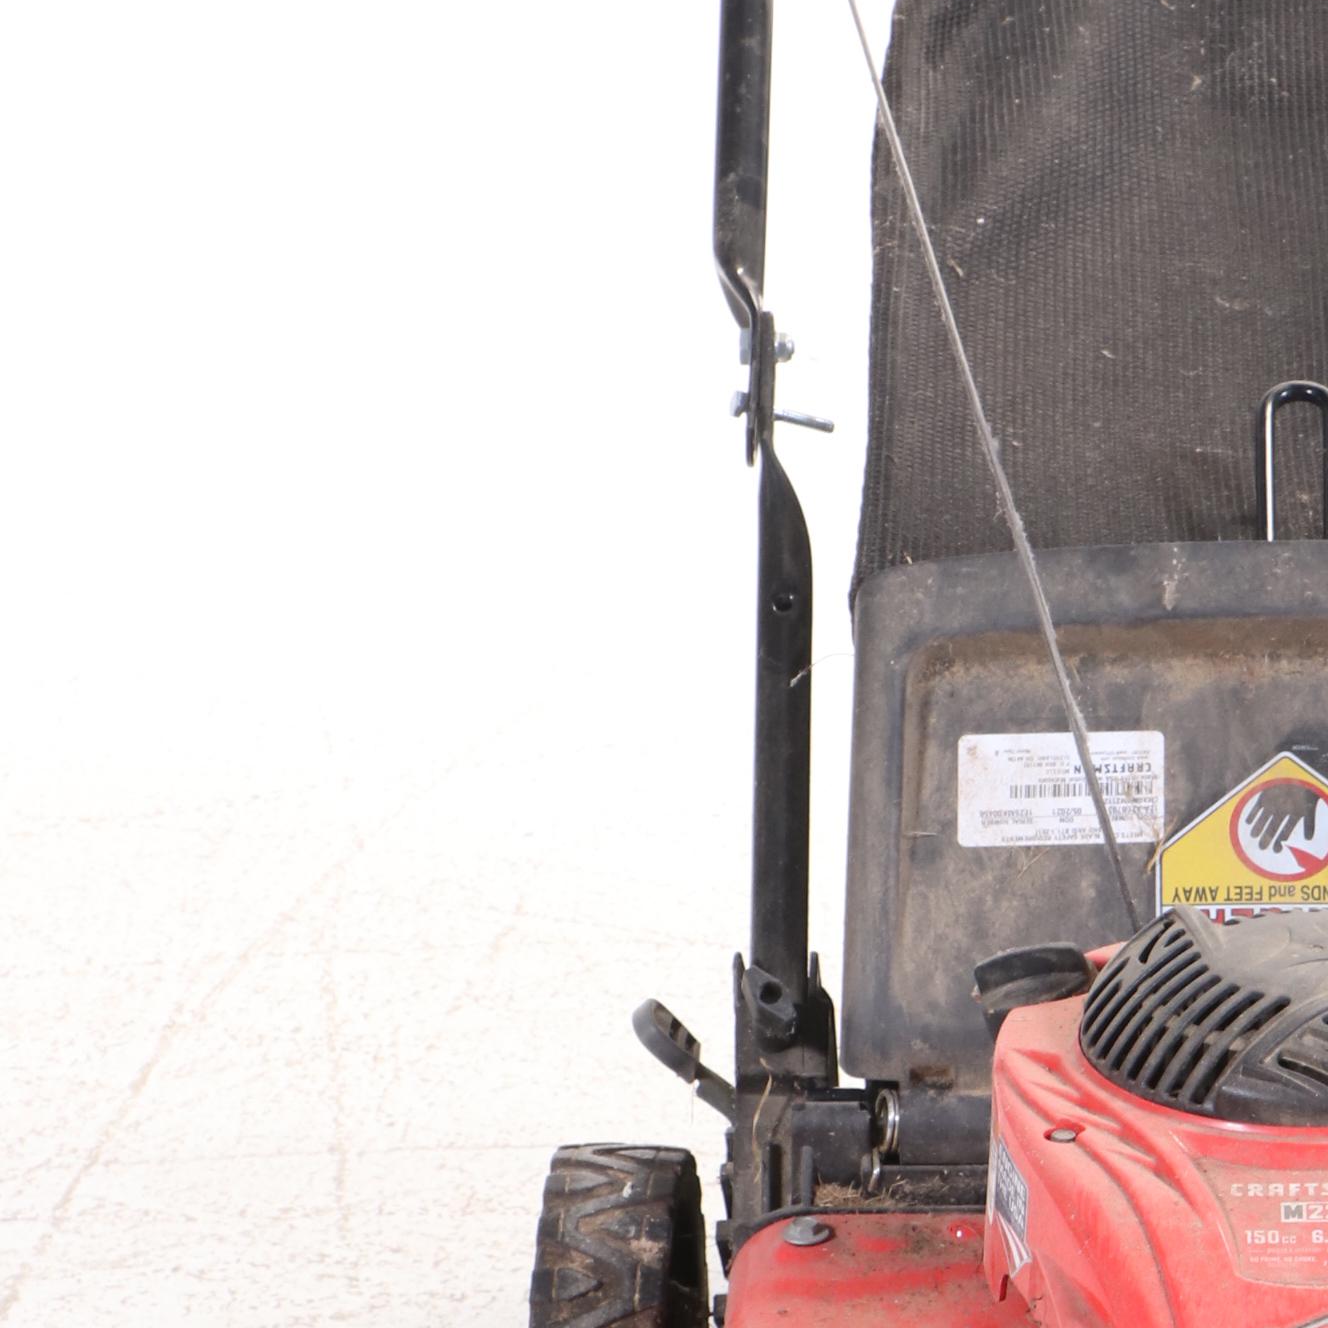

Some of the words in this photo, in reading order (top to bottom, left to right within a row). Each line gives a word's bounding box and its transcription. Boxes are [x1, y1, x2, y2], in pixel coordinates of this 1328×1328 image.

[1073, 763, 1152, 774] CRAFTSMN
[1171, 886, 1220, 903] AWAY
[1224, 886, 1263, 902] FEET
[1269, 885, 1296, 902] and
